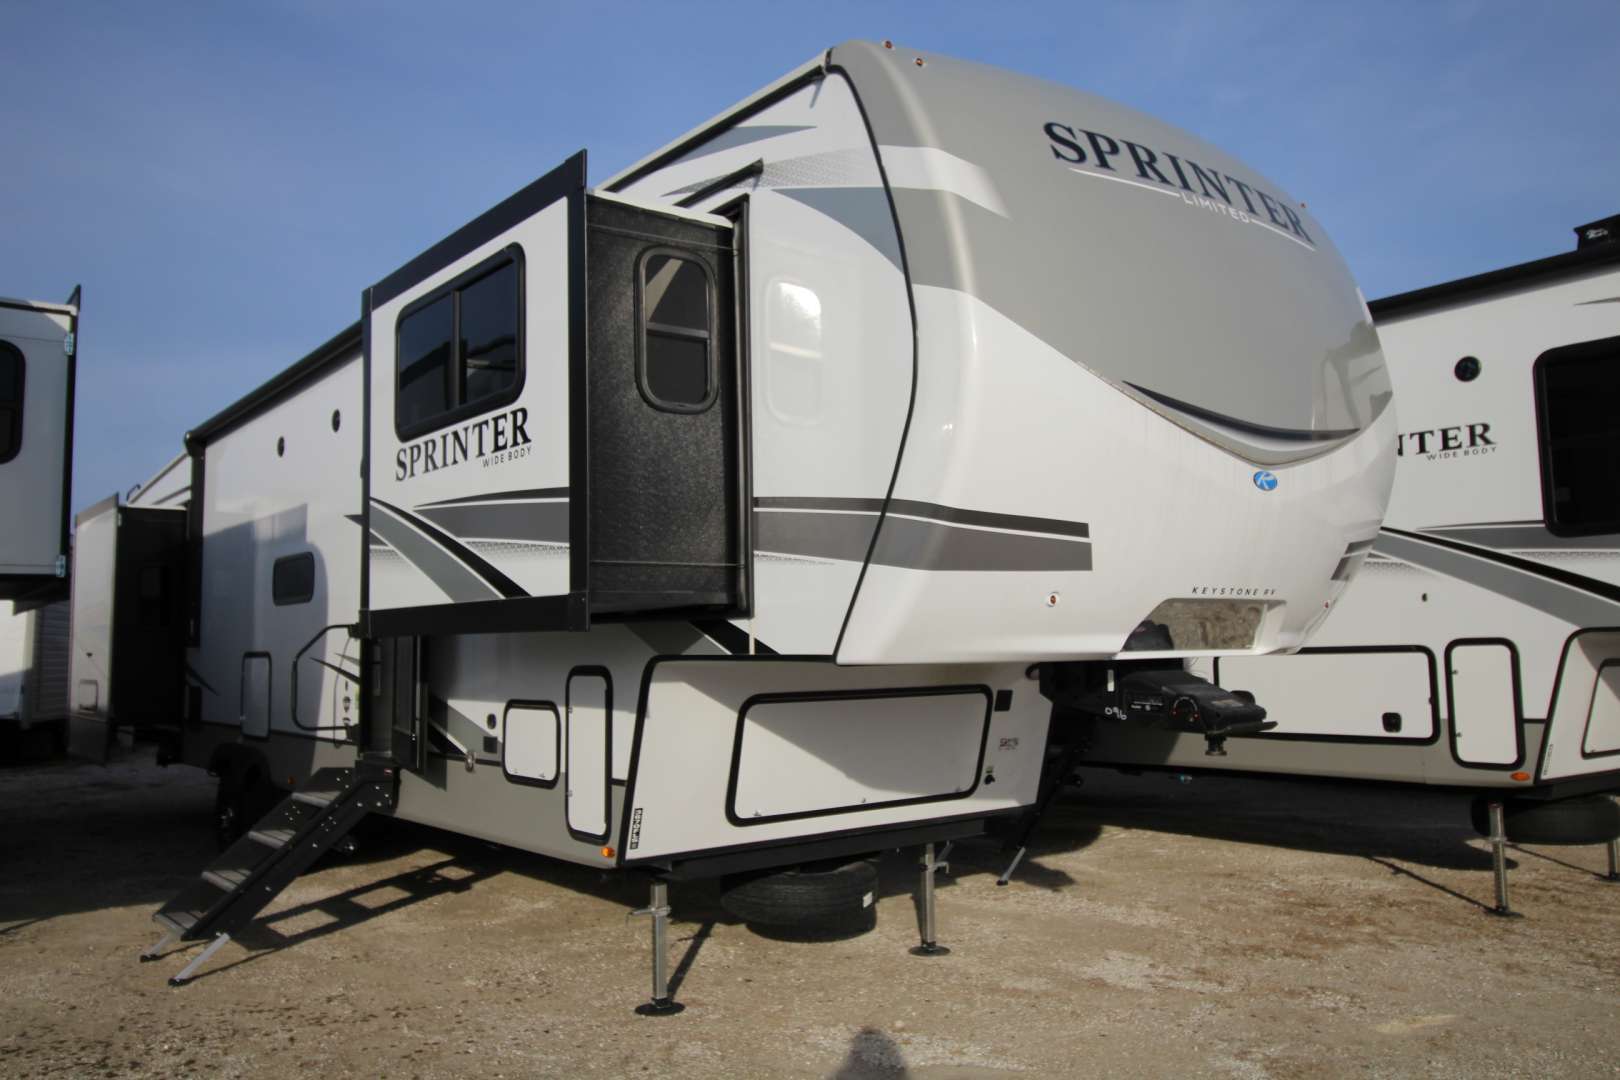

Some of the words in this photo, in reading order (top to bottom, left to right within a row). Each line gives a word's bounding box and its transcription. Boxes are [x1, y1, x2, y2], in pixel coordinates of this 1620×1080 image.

[1043, 121, 1315, 245] SPRINTER
[1180, 192, 1250, 223] LIMITED
[395, 407, 532, 482] SPRINTER
[482, 453, 505, 469] WIDE
[508, 445, 532, 461] BODY
[1426, 450, 1459, 461] WIDE
[1463, 445, 1497, 457] BODY
[1191, 586, 1260, 597] KEYSTONE
